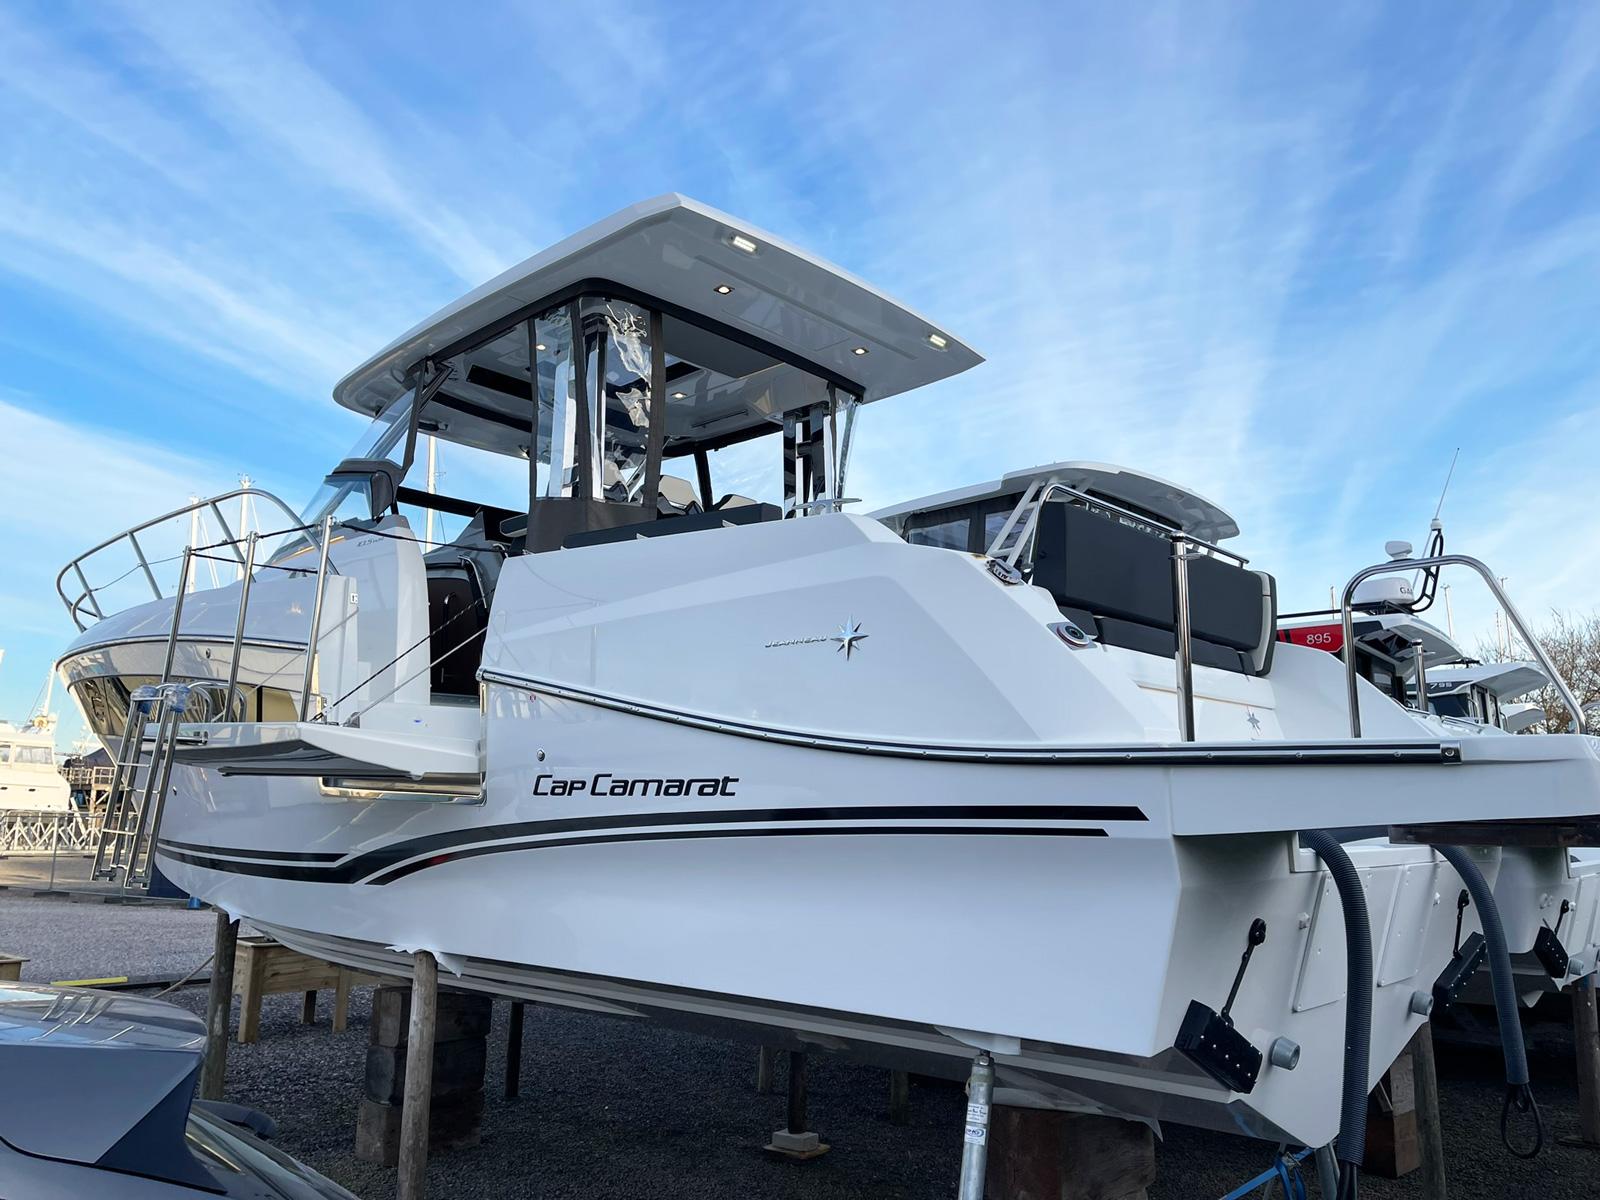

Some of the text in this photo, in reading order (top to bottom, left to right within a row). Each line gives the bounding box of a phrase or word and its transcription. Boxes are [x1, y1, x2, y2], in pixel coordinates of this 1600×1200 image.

[1306, 632, 1332, 645] 895
[533, 773, 740, 797] Cap Camarat
